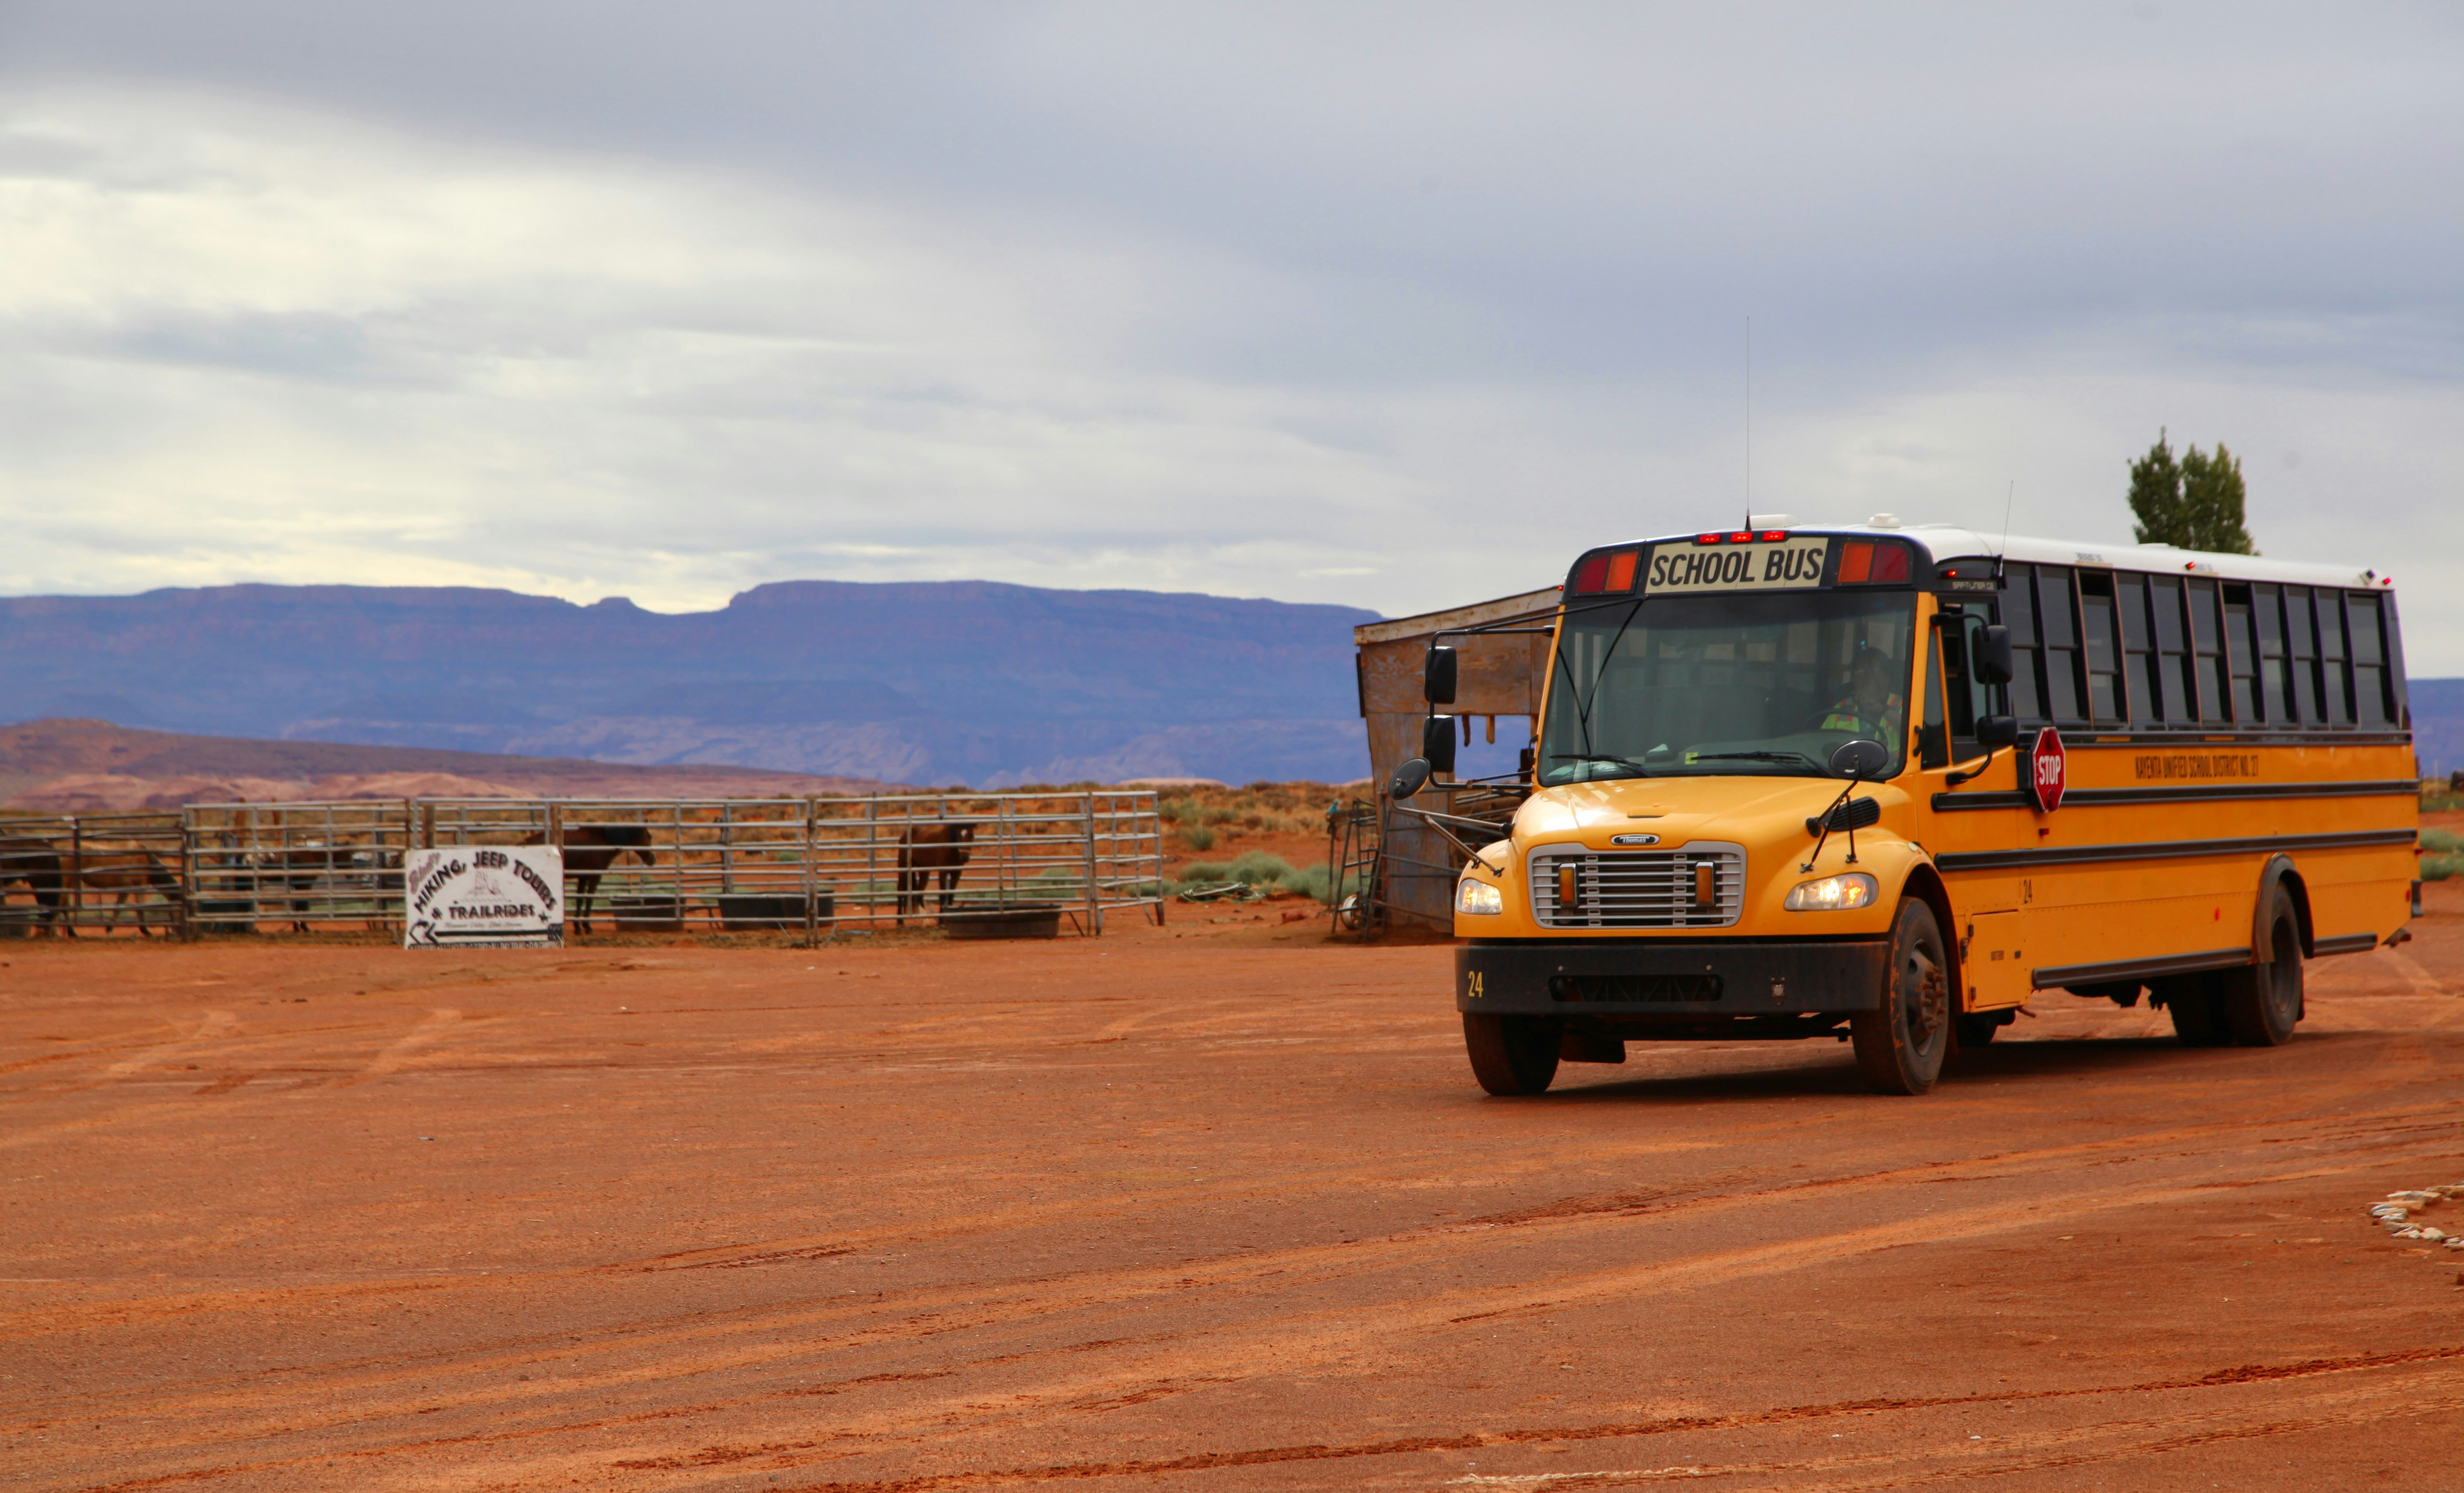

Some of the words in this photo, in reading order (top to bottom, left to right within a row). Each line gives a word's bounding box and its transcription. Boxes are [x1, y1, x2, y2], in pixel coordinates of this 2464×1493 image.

[1650, 551, 1755, 586] SCHOOL
[1764, 548, 1823, 581] BUS
[2038, 755, 2061, 785] STOP
[2135, 756, 2162, 779] KAYENTA
[2163, 756, 2188, 779] UNIFIED
[2188, 755, 2212, 778] SCHOOL
[2213, 755, 2238, 777] DISTRICT
[2251, 754, 2259, 777] 27
[415, 858, 467, 915] HIKING,
[473, 851, 509, 869] JEEP
[513, 858, 558, 911] TOURS
[2023, 879, 2032, 904] 24
[449, 904, 536, 919] TRAILRIDES
[1468, 970, 1483, 998] 24
